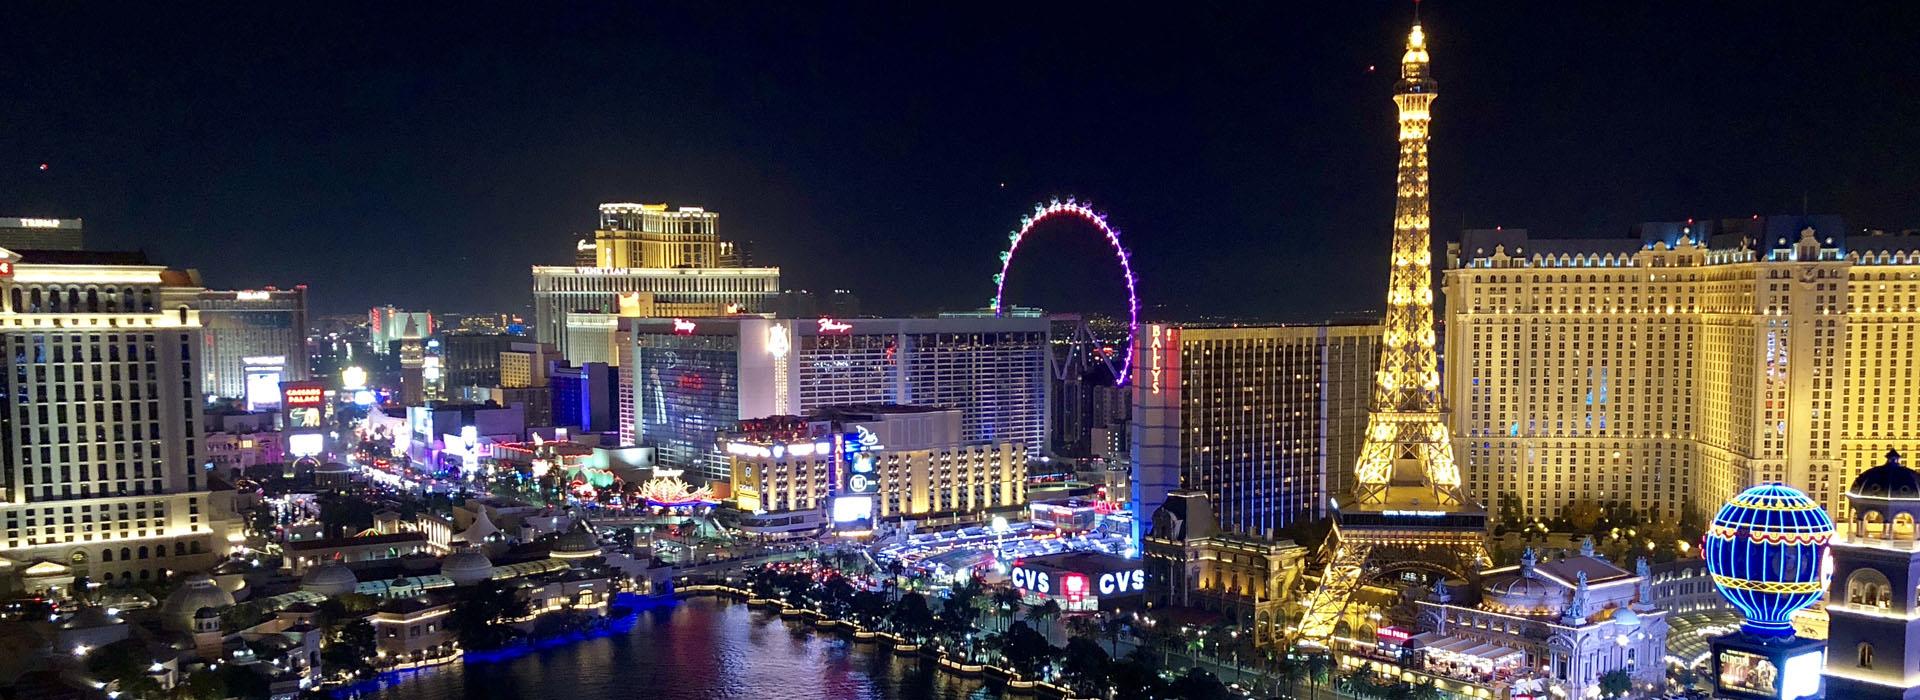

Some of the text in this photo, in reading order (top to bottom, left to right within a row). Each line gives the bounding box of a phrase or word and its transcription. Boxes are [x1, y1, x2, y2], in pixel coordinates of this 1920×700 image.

[20, 218, 60, 228] TRUMP
[577, 266, 629, 276] VENETIAN
[286, 388, 321, 396] CAESARS
[288, 395, 320, 403] PALACE
[1011, 566, 1051, 594] CVS
[1099, 568, 1145, 595] CVS
[1392, 630, 1408, 640] PARK
